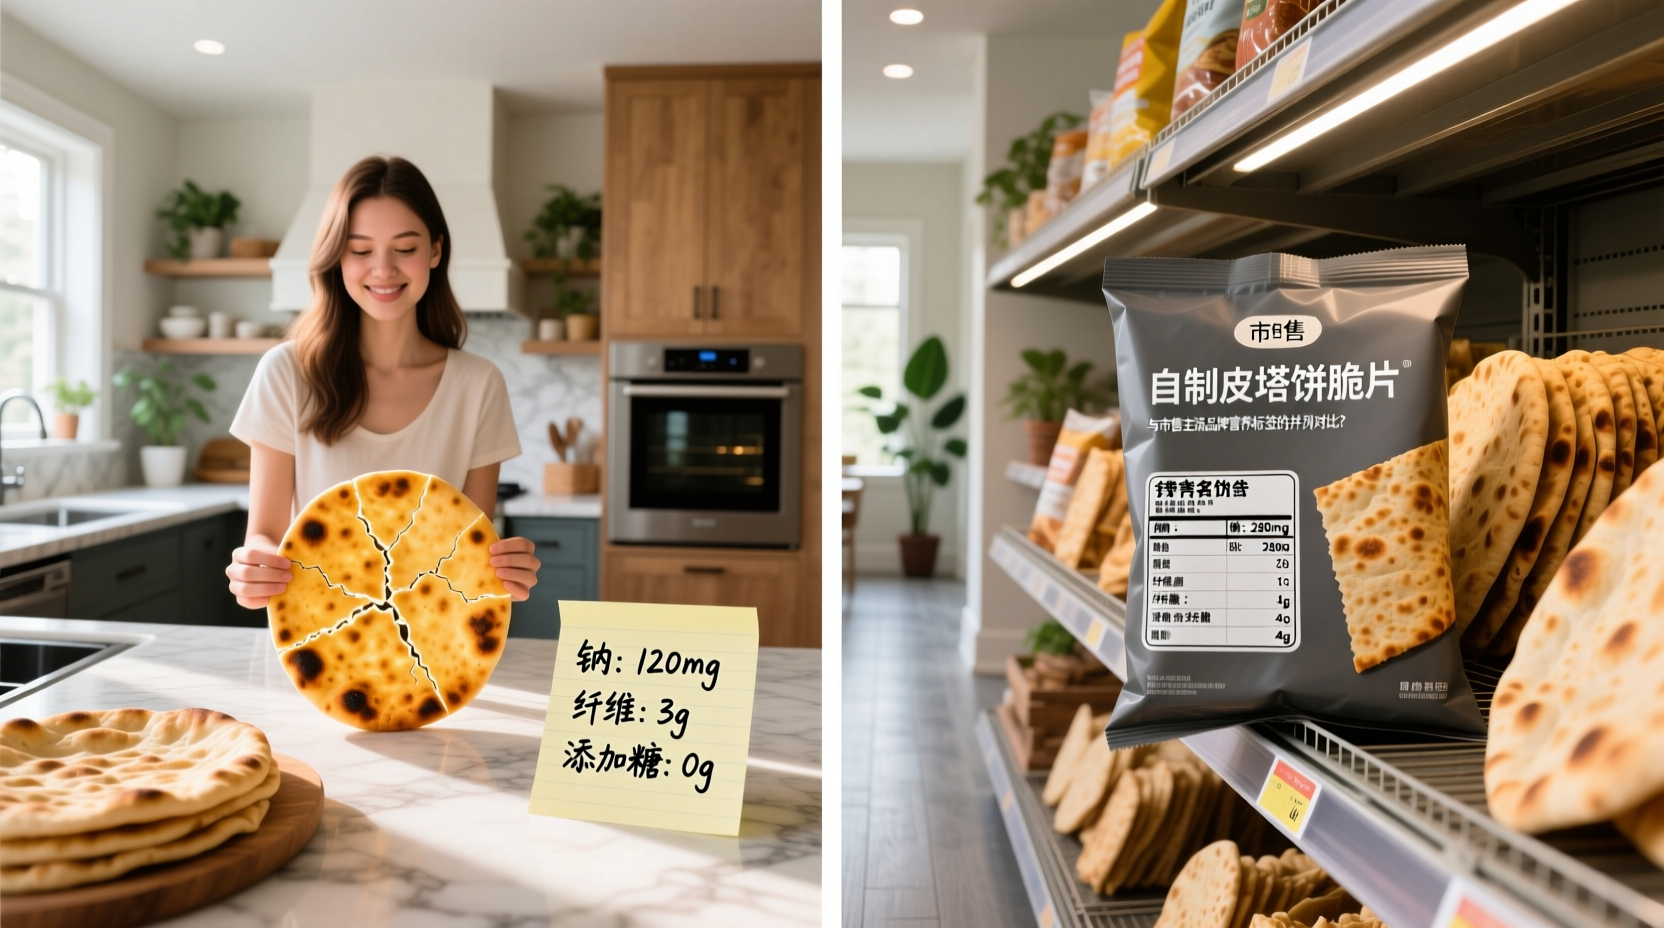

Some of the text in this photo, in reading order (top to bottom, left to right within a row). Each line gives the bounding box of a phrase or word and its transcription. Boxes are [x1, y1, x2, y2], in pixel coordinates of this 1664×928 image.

[1152, 360, 1399, 405] 自制皮塔饼脆片
[638, 648, 720, 691] 120mg
[657, 699, 689, 739] 3g
[682, 753, 714, 793] 0g
